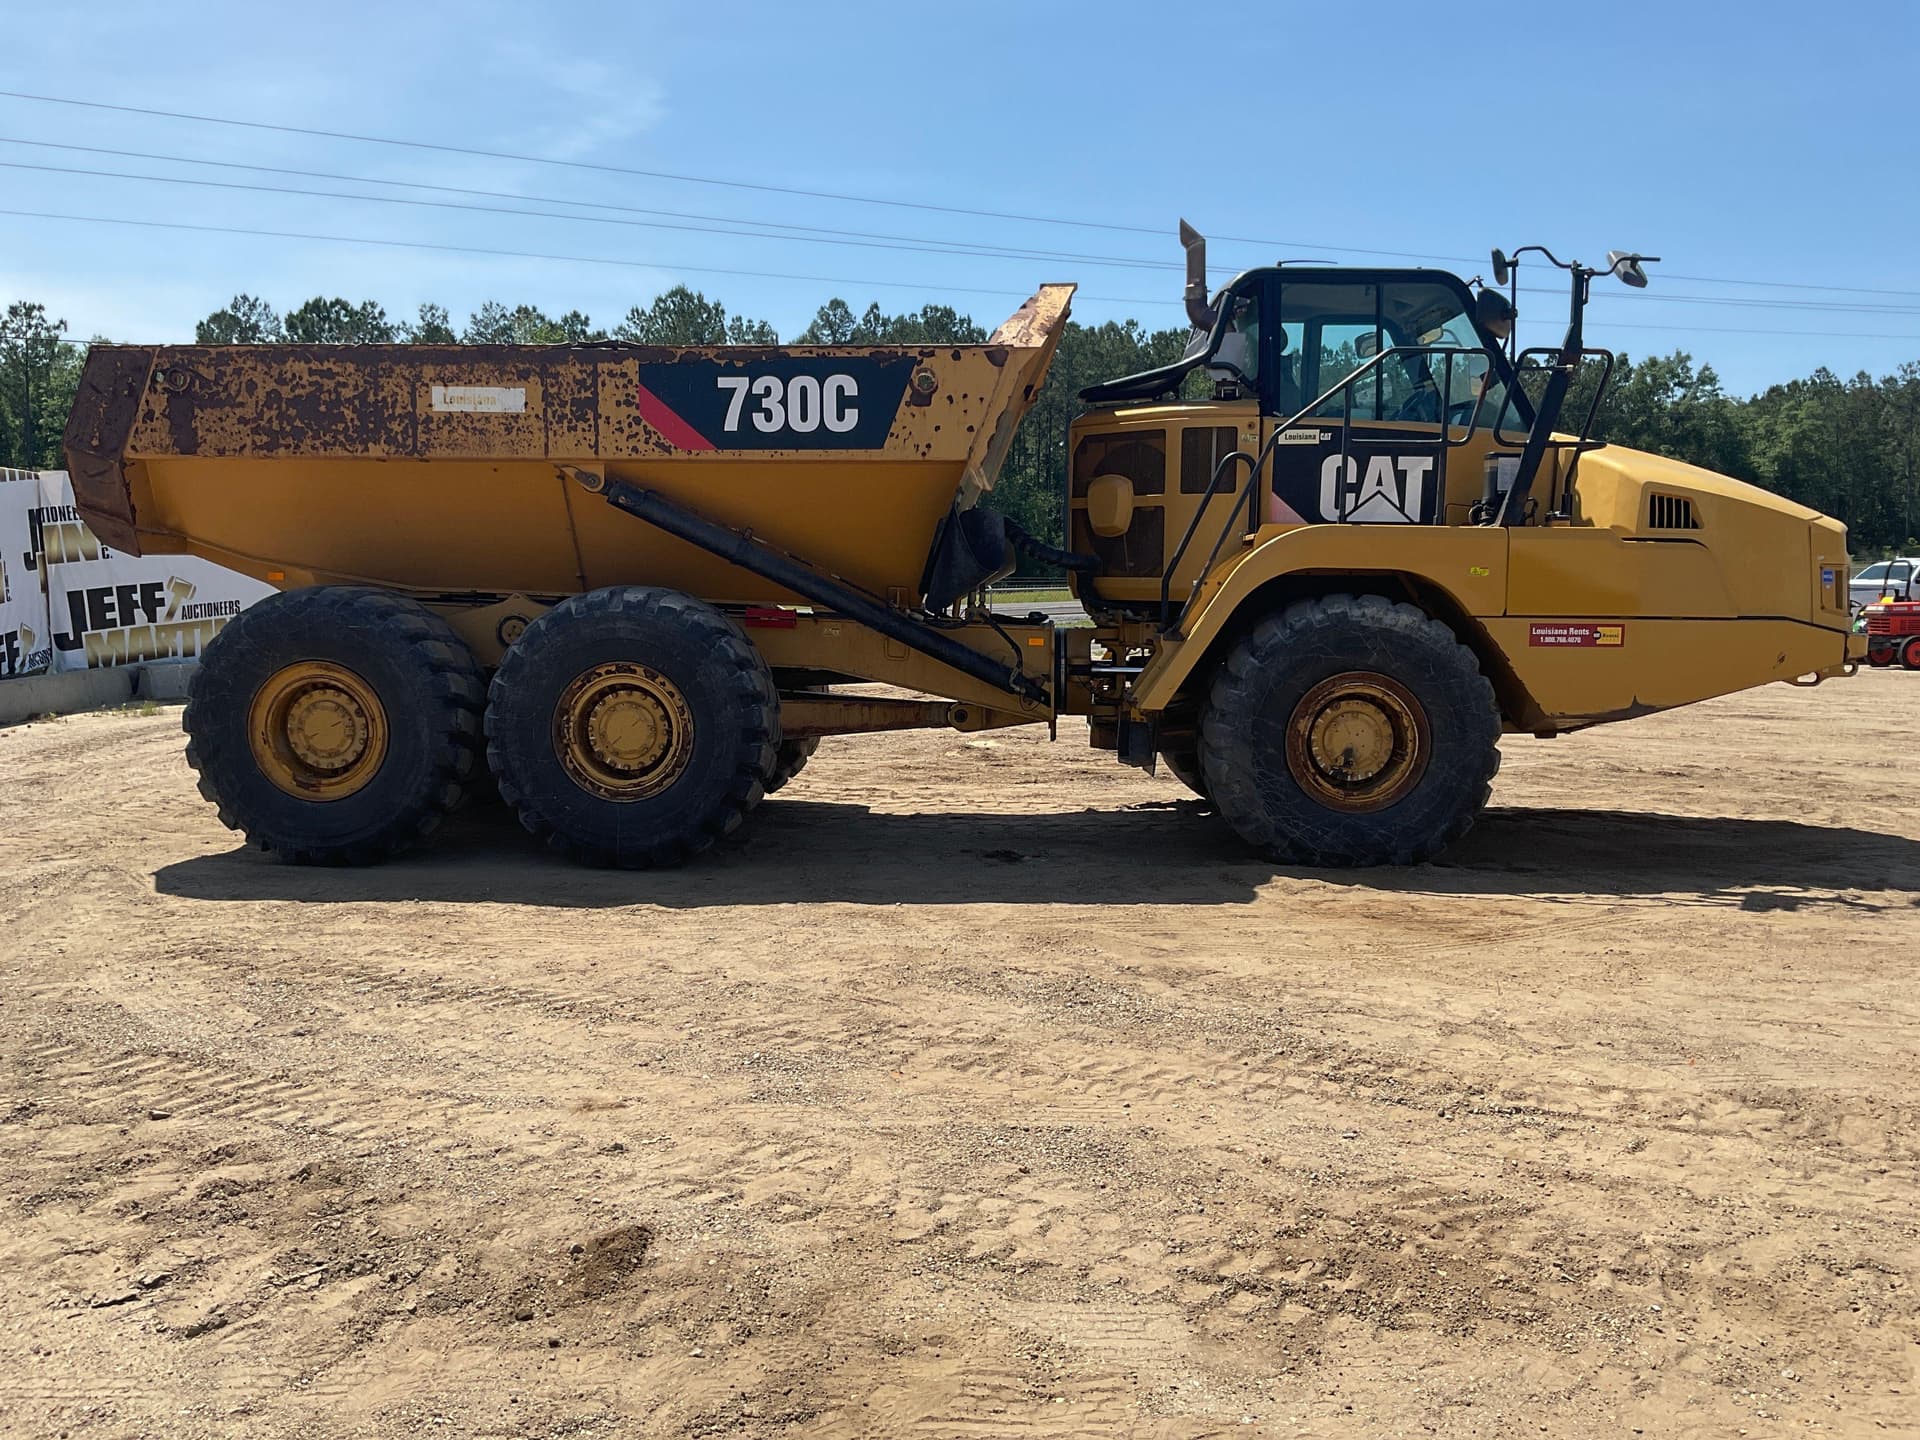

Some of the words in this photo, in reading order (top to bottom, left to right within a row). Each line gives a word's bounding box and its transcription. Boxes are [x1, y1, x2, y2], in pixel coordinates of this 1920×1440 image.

[716, 374, 859, 433] 730C
[1284, 433, 1317, 441] Louisiana
[1319, 453, 1433, 523] CAT
[53, 582, 166, 651] JEFF
[181, 600, 241, 621] AUCTIONEERS
[1532, 627, 1567, 635] Louisiana
[1569, 627, 1590, 636] Rents
[84, 618, 229, 669] MARTI
